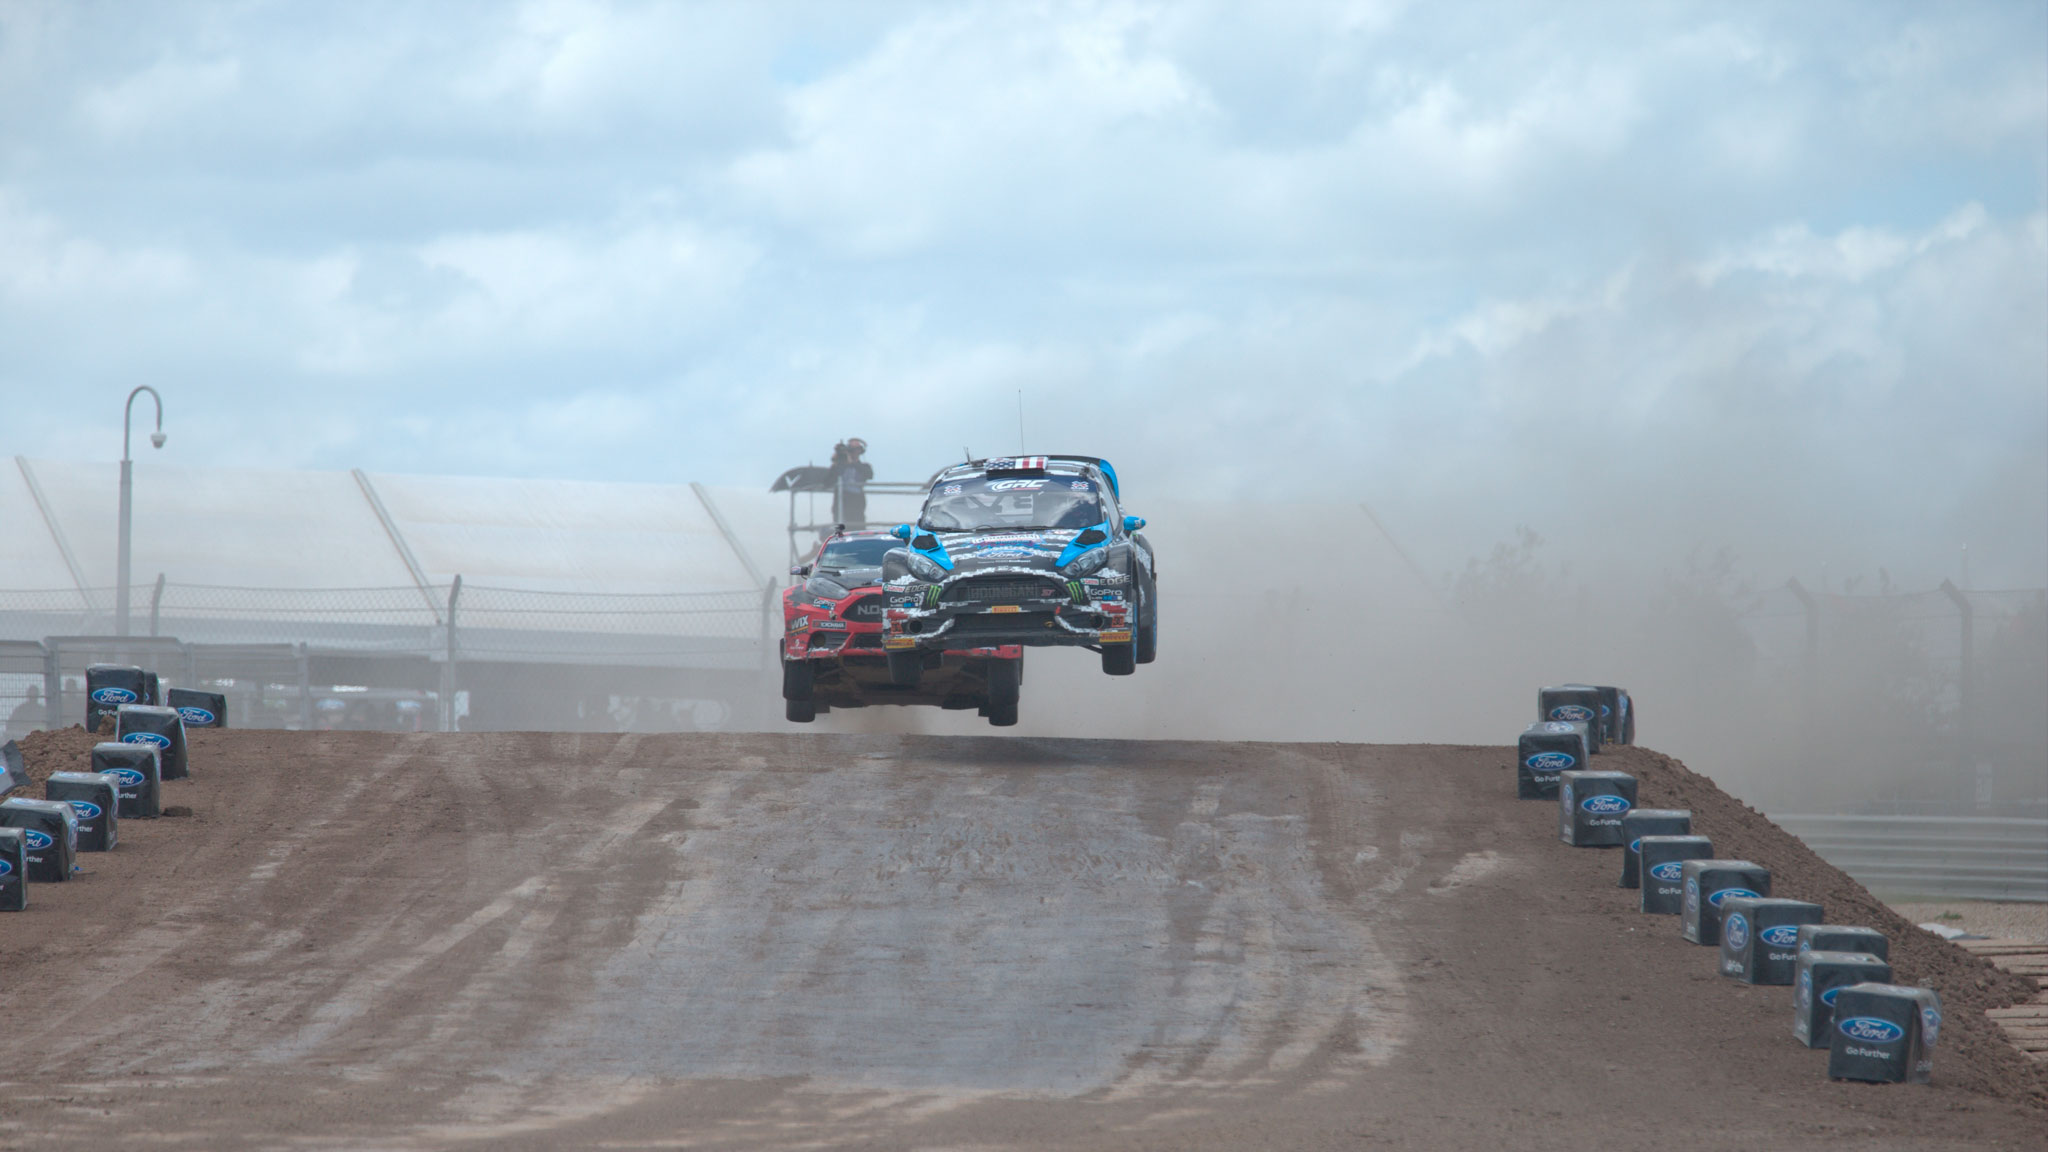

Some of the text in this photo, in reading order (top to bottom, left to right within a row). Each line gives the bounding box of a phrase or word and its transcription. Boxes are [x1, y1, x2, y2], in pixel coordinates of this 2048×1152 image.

[996, 479, 1049, 489] GRC
[1100, 575, 1130, 586] EDGE
[905, 585, 928, 593] EDGE
[1091, 588, 1122, 596] GoPro
[813, 598, 836, 607] GoPro
[100, 690, 129, 703] Ford
[180, 709, 207, 721] Ford
[1558, 707, 1585, 720] Ford
[1536, 755, 1565, 767] Ford
[1591, 798, 1621, 811] Ford
[1851, 1020, 1891, 1039] Ford
[1846, 1046, 1890, 1060] Go Further
